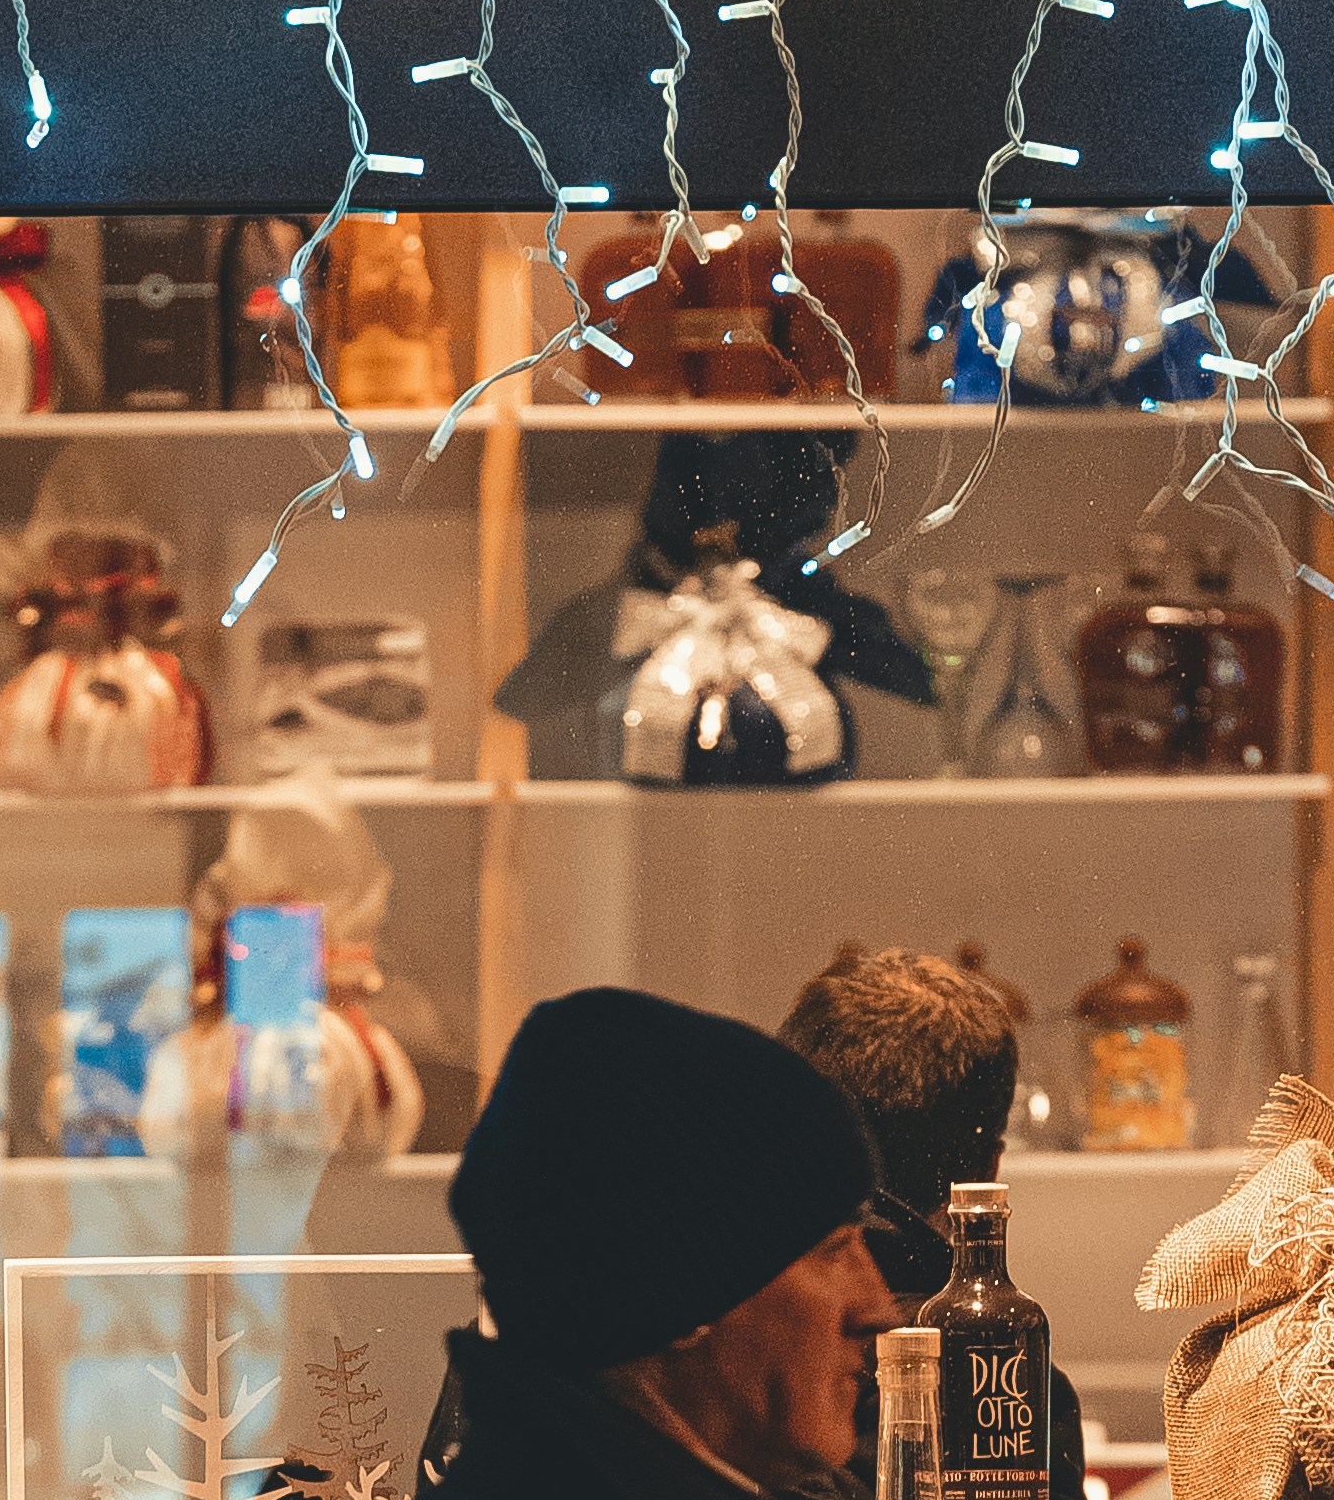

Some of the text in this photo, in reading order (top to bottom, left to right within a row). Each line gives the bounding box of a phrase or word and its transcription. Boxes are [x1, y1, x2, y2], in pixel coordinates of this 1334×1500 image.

[978, 1396, 1033, 1430] OTTO
[972, 1429, 1035, 1460] LUNE
[975, 1489, 1031, 1499] DISTILLERIA
